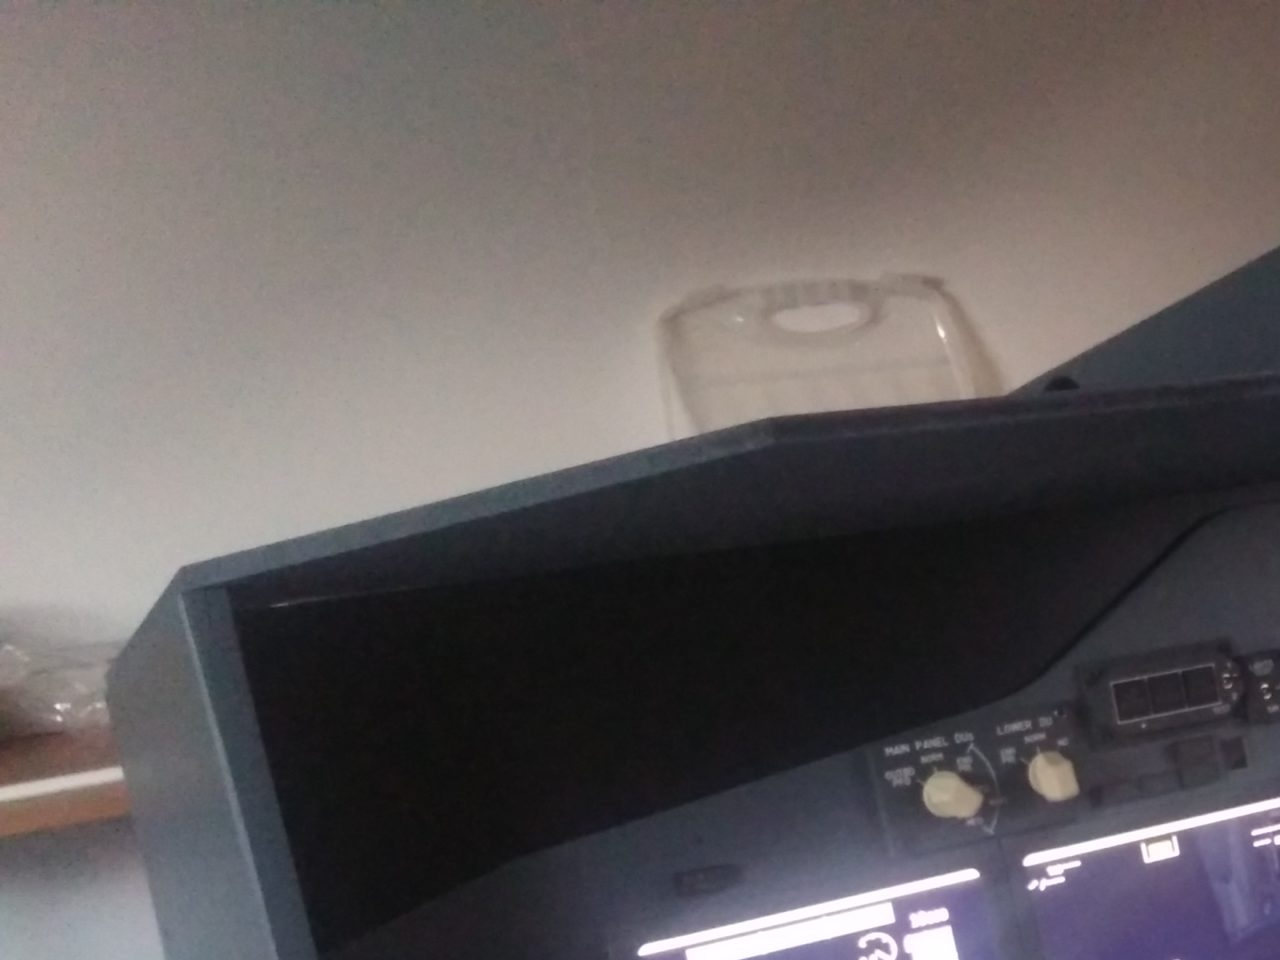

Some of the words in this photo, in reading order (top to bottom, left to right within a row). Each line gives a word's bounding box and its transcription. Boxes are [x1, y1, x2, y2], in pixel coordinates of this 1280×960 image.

[996, 719, 1032, 735] LOWER
[884, 743, 910, 757] MAIN
[915, 736, 948, 751] PANEL
